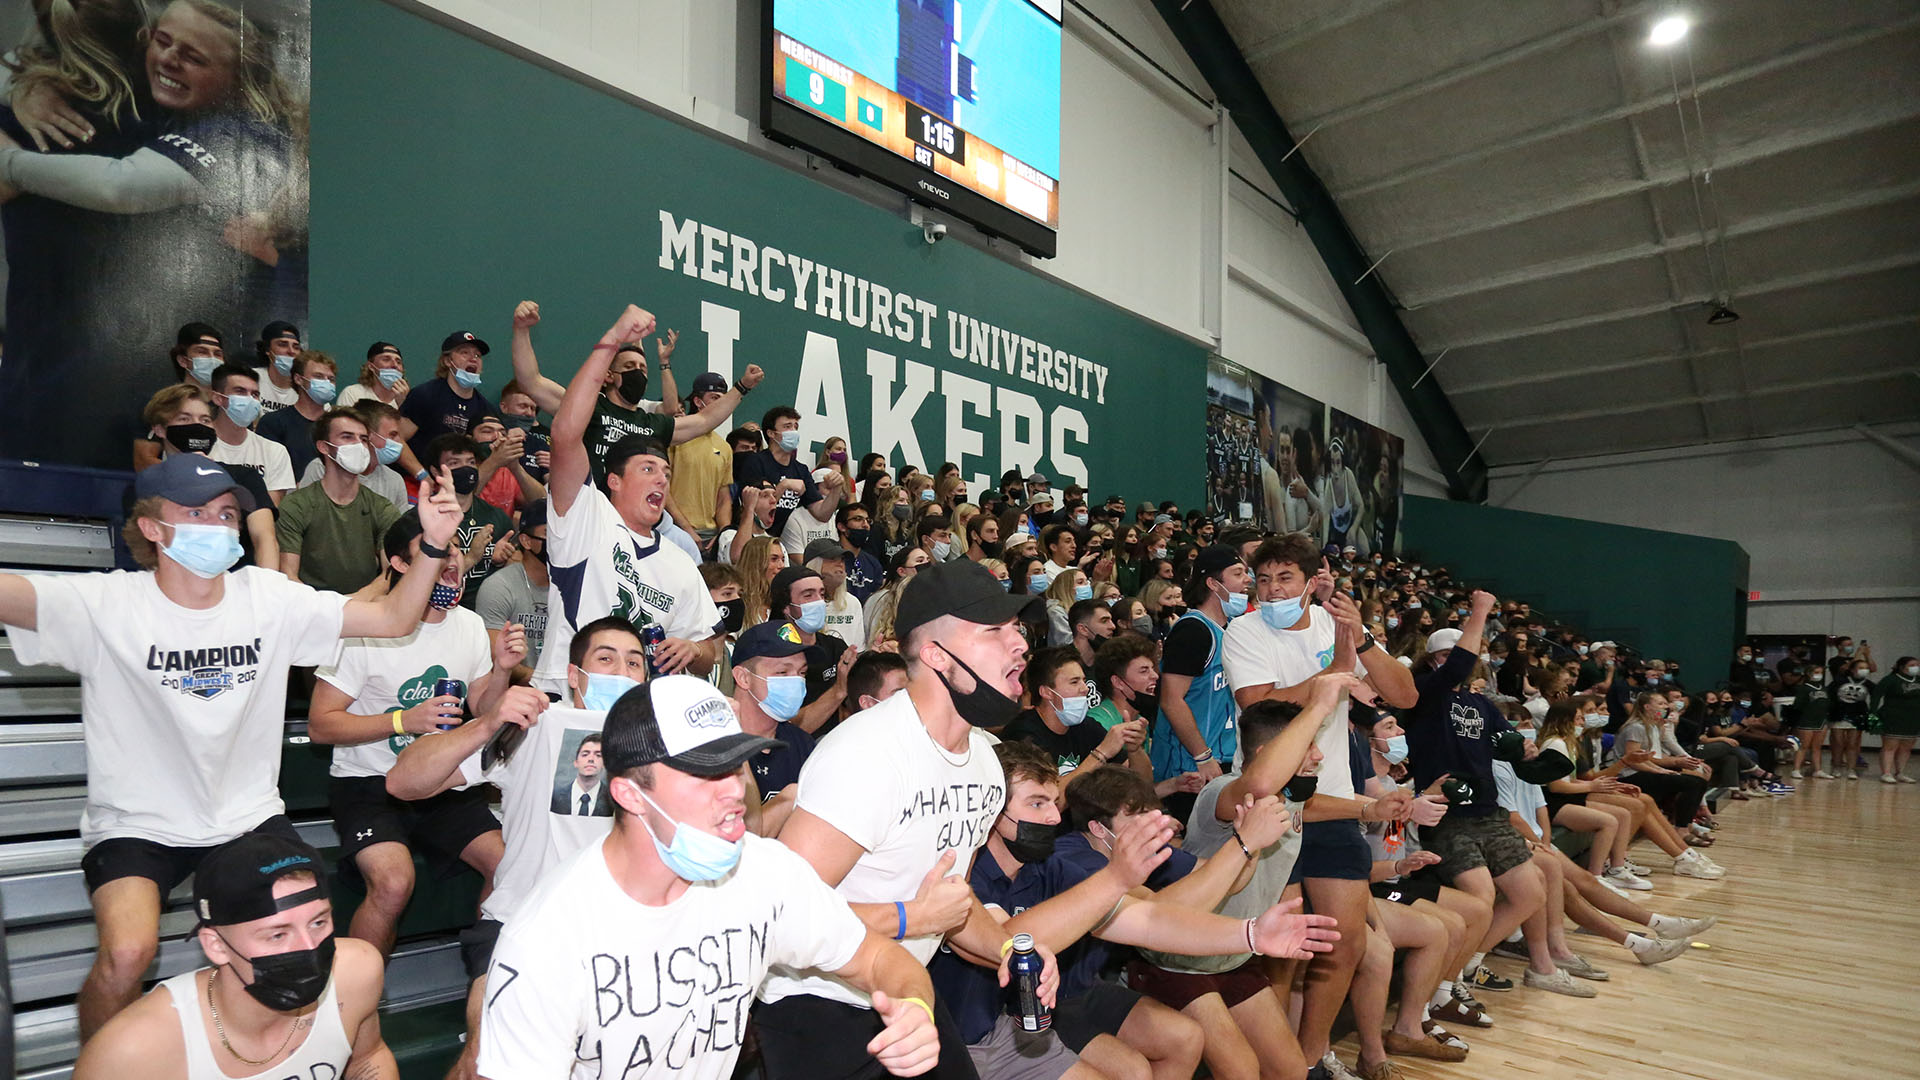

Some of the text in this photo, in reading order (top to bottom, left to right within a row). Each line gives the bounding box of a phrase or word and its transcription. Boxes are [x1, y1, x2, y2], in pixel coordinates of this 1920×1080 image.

[809, 72, 824, 105] 9
[921, 114, 955, 155] 1:15
[915, 145, 933, 167] SET
[923, 182, 950, 200] NEVCO
[659, 209, 1109, 405] MERCYHURST UNIVERSITY
[601, 415, 654, 436] MERCYHURST
[701, 300, 1090, 511] LAKERS
[613, 542, 675, 613] MERHURST
[194, 671, 220, 680] GREAT
[899, 783, 1003, 825] WHATEVER
[936, 814, 990, 852] GUYS
